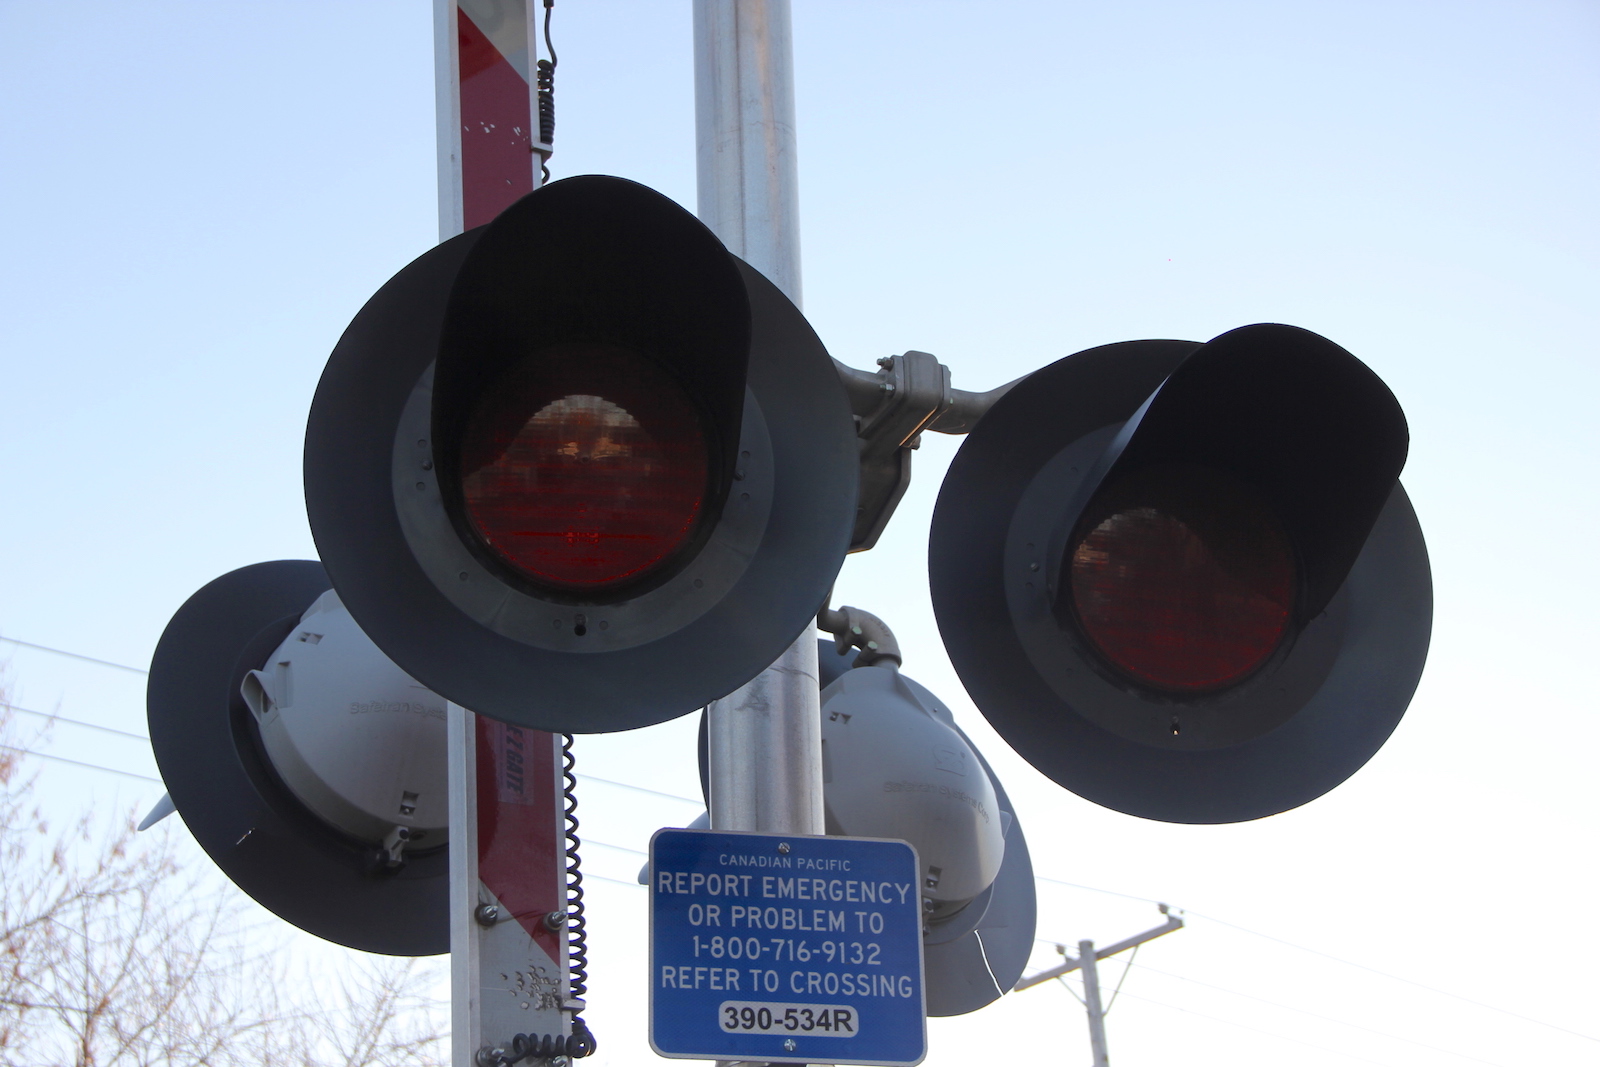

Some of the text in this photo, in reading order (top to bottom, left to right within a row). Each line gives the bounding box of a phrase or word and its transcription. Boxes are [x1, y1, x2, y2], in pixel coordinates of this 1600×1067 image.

[506, 749, 525, 794] GATE
[719, 853, 851, 872] CANADIAN PACIFIC
[658, 872, 911, 904] REPORT EMERGENCY
[688, 904, 884, 935] OR PROBLEM TO
[693, 935, 881, 965] 1-800-716-9132
[662, 966, 913, 998] REFER TO CROSSING
[724, 1007, 854, 1032] 390-534R
